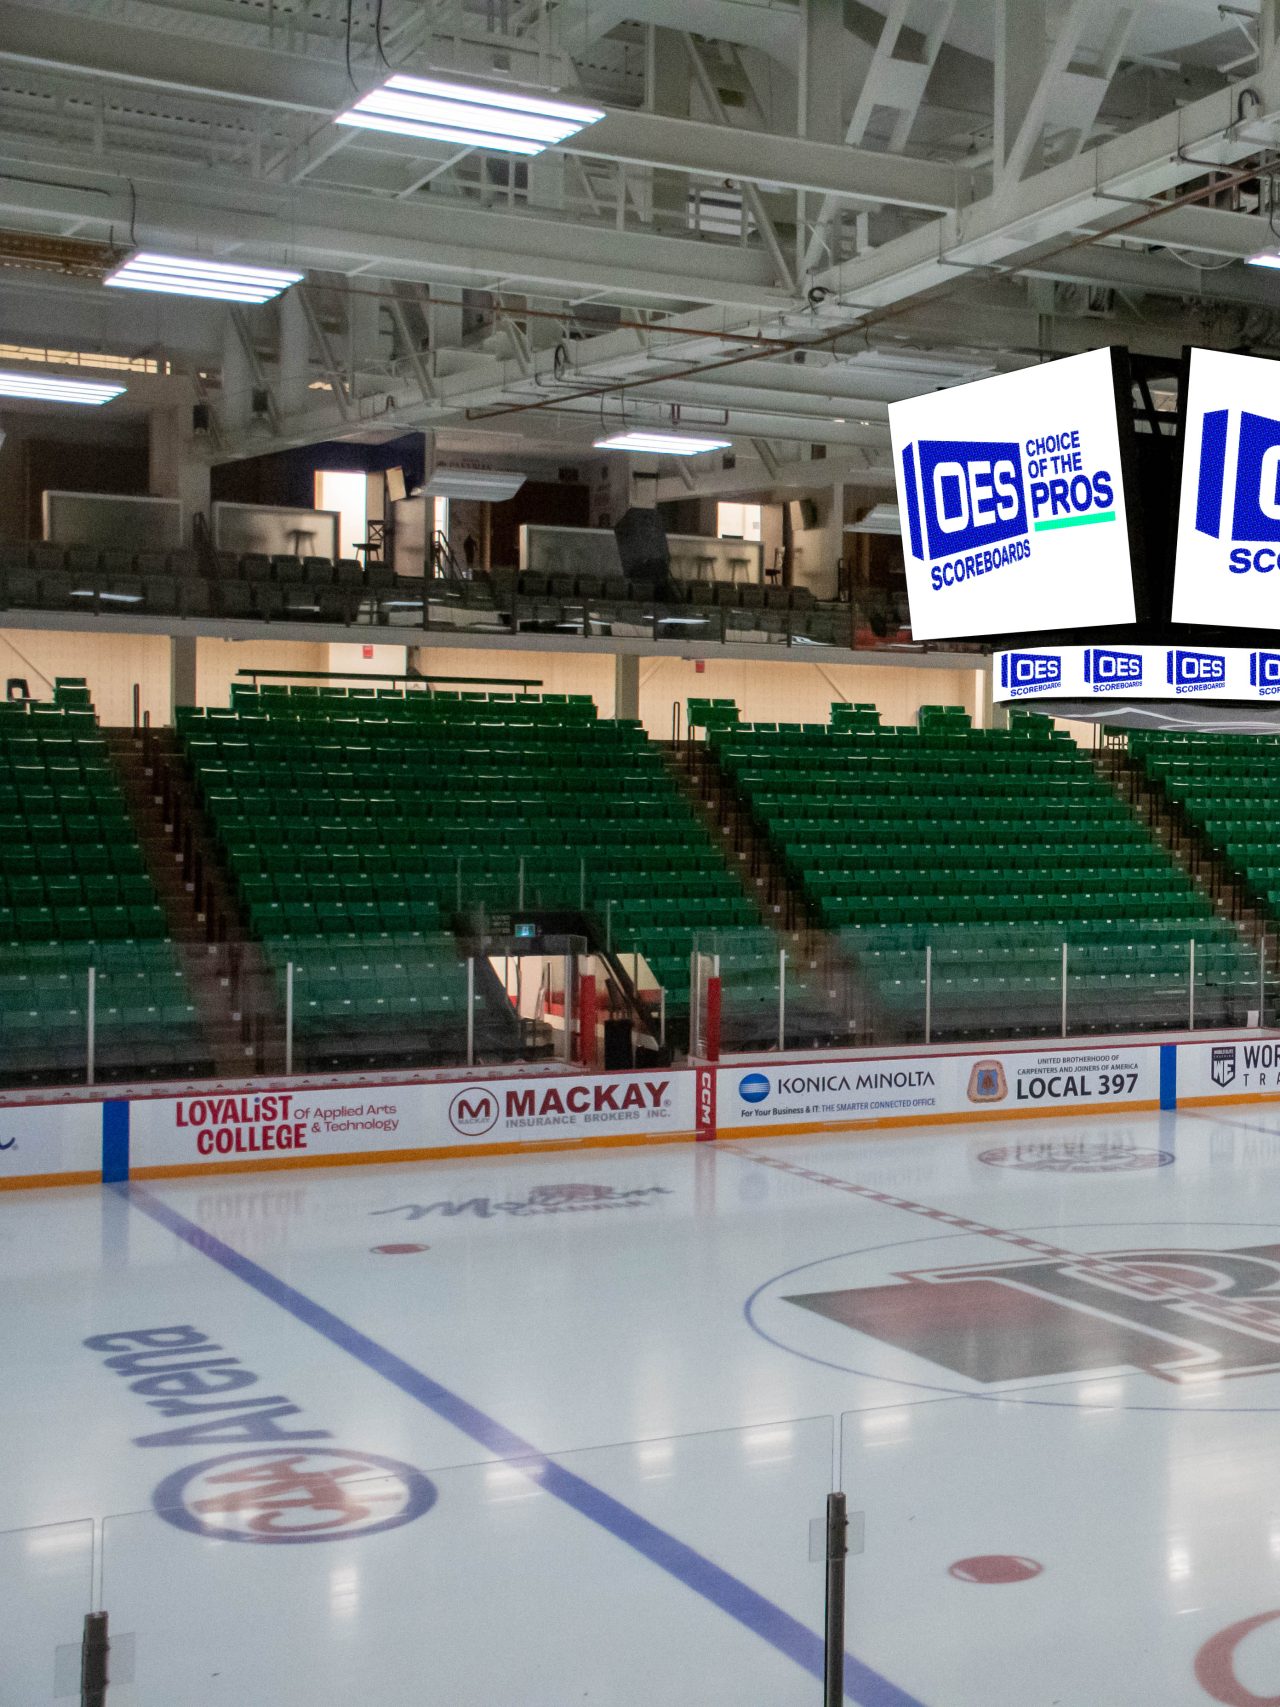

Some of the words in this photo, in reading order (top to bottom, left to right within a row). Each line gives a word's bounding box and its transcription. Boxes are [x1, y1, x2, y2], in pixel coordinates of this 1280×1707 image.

[1026, 430, 1080, 457] CHOICE
[1028, 457, 1048, 478] OF
[1050, 452, 1082, 475] THE
[933, 459, 1019, 534] OES
[1030, 470, 1114, 518] PROS
[930, 539, 1031, 590] SCOREBOARDS
[1016, 659, 1059, 681] OES
[1099, 656, 1140, 677] OES
[1182, 657, 1223, 679] OES
[1010, 682, 1061, 697] SCOREBOARDS
[1093, 680, 1143, 693] SCOREBOARDS
[1175, 682, 1225, 694] SCOREBOARDS
[1017, 1066, 1058, 1076] CARPENTERS
[1059, 1066, 1073, 1074] AND
[1074, 1064, 1100, 1073] JOINERS
[1101, 1063, 1109, 1071] OF
[1110, 1062, 1138, 1071] AMERICA
[1037, 1056, 1061, 1065] UNITED
[1062, 1054, 1110, 1064] BROTHERHOOD
[1111, 1054, 1120, 1062] OF
[778, 1075, 851, 1094] KONICA
[856, 1071, 935, 1090] MINOLTA
[1016, 1075, 1092, 1100] LOCAL
[1098, 1073, 1139, 1095] 397
[457, 1097, 491, 1119] M
[505, 1080, 670, 1118] MACKAY
[700, 1072, 712, 1125] CCM
[741, 1108, 753, 1118] For
[754, 1107, 771, 1117] Your
[772, 1105, 804, 1115] Business
[805, 1105, 812, 1113] &
[822, 1103, 836, 1113] THE
[836, 1101, 869, 1112] SMARTER
[870, 1098, 912, 1110] CONNECTED
[912, 1097, 936, 1107] OFFICE
[294, 1107, 311, 1120] Of
[313, 1105, 364, 1123] Applied
[366, 1103, 398, 1115] Arts
[505, 1114, 577, 1129] INSURANCE
[584, 1110, 640, 1124] BROKERS
[647, 1108, 671, 1119] INC.
[311, 1122, 321, 1133] &
[323, 1117, 399, 1133] Technology
[197, 1123, 307, 1155] COLLEGE
[82, 1324, 335, 1448] Arena
